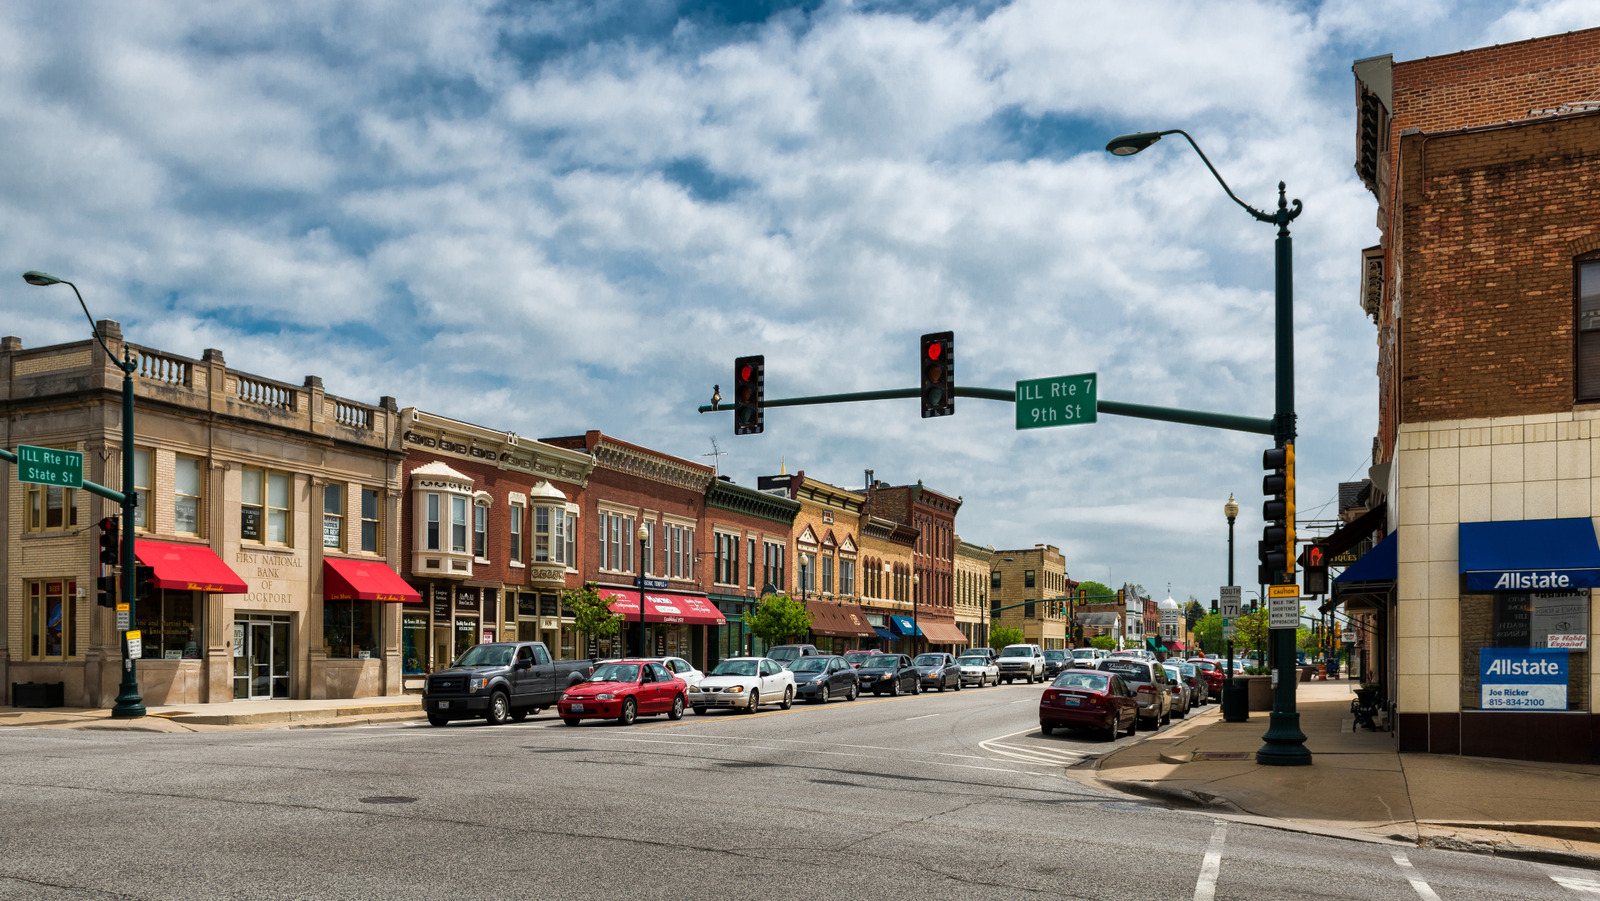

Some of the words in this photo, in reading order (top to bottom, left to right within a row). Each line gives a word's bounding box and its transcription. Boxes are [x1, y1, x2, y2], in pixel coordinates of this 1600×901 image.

[1020, 384, 1043, 400] ILL
[1052, 382, 1077, 398] Rte
[1084, 379, 1093, 394] 7
[1031, 407, 1057, 422] 9th
[1065, 404, 1082, 420] St
[22, 450, 39, 462] ILL
[44, 452, 60, 464] Rte
[66, 455, 79, 467] 171
[28, 468, 56, 480] State
[62, 472, 73, 483] St
[236, 552, 258, 564] FIRST
[262, 555, 302, 568] NATIONAL
[257, 567, 279, 578] BANK
[1494, 572, 1569, 589] Allstate
[261, 580, 273, 590] OF
[243, 592, 293, 604] LOCKPORT
[1224, 606, 1238, 615] 171
[1486, 659, 1558, 675] Allstate
